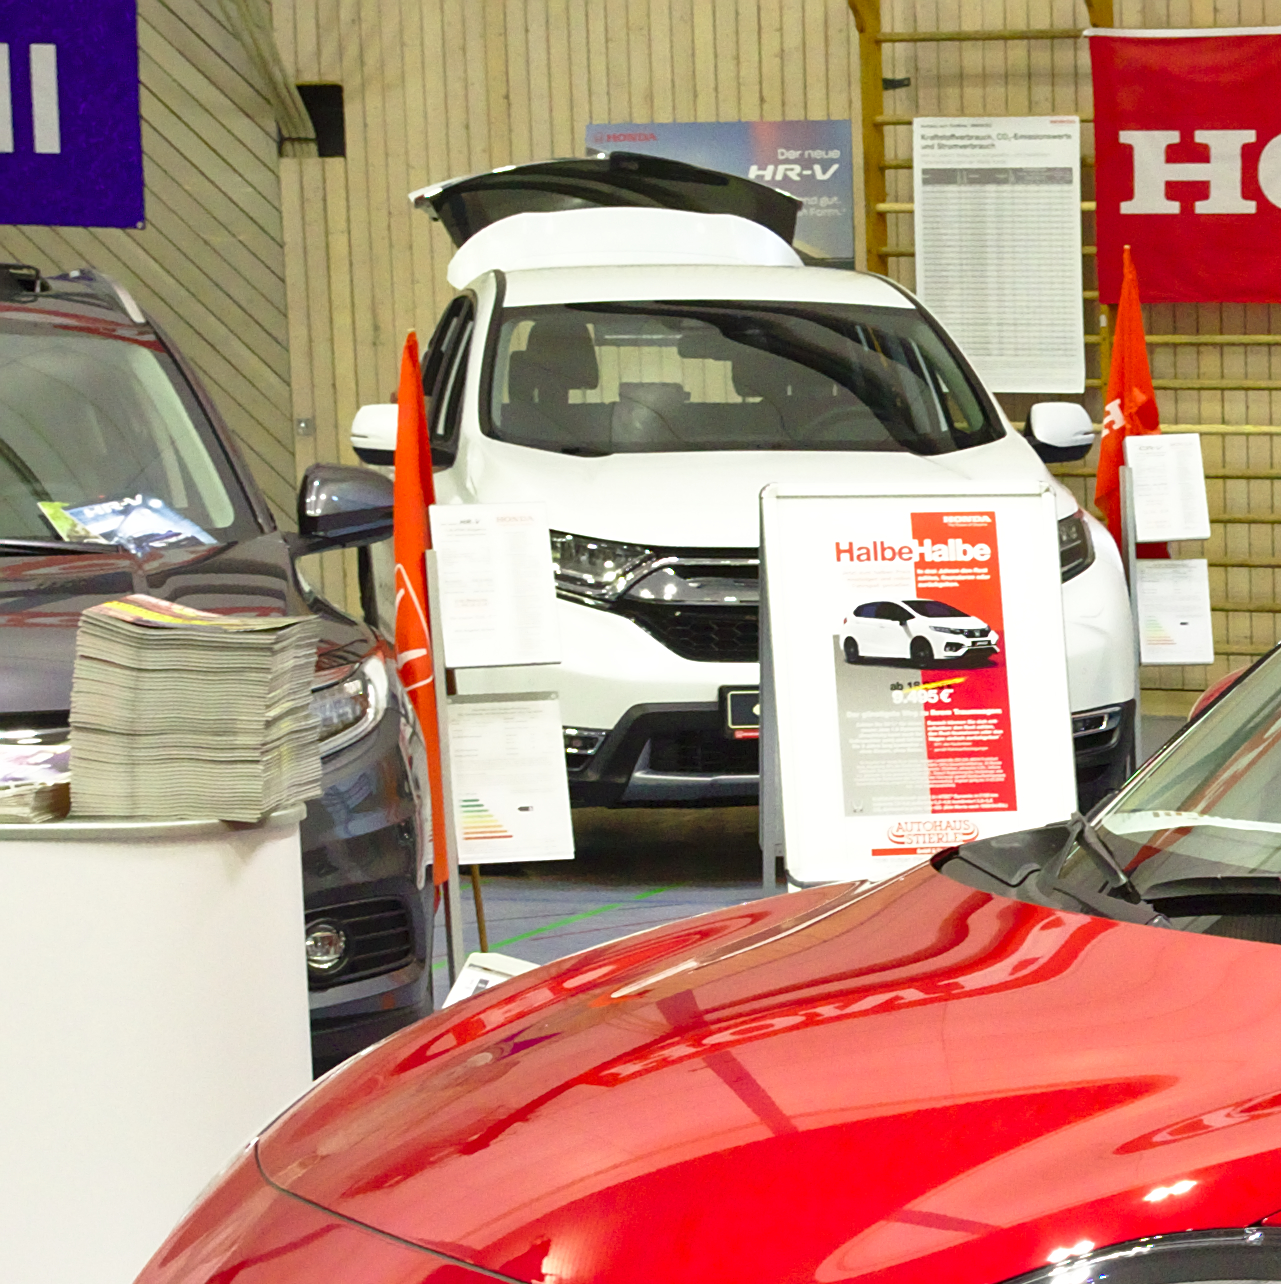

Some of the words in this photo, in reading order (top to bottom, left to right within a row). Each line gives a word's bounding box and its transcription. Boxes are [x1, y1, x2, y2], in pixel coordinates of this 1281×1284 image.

[606, 132, 657, 143] HONDA
[777, 148, 802, 160] Der
[804, 149, 841, 159] neue
[748, 163, 840, 181] HR-V
[890, 681, 904, 691] ab
[896, 819, 971, 833] AUTOHAUS
[905, 832, 962, 845] STIERLE
